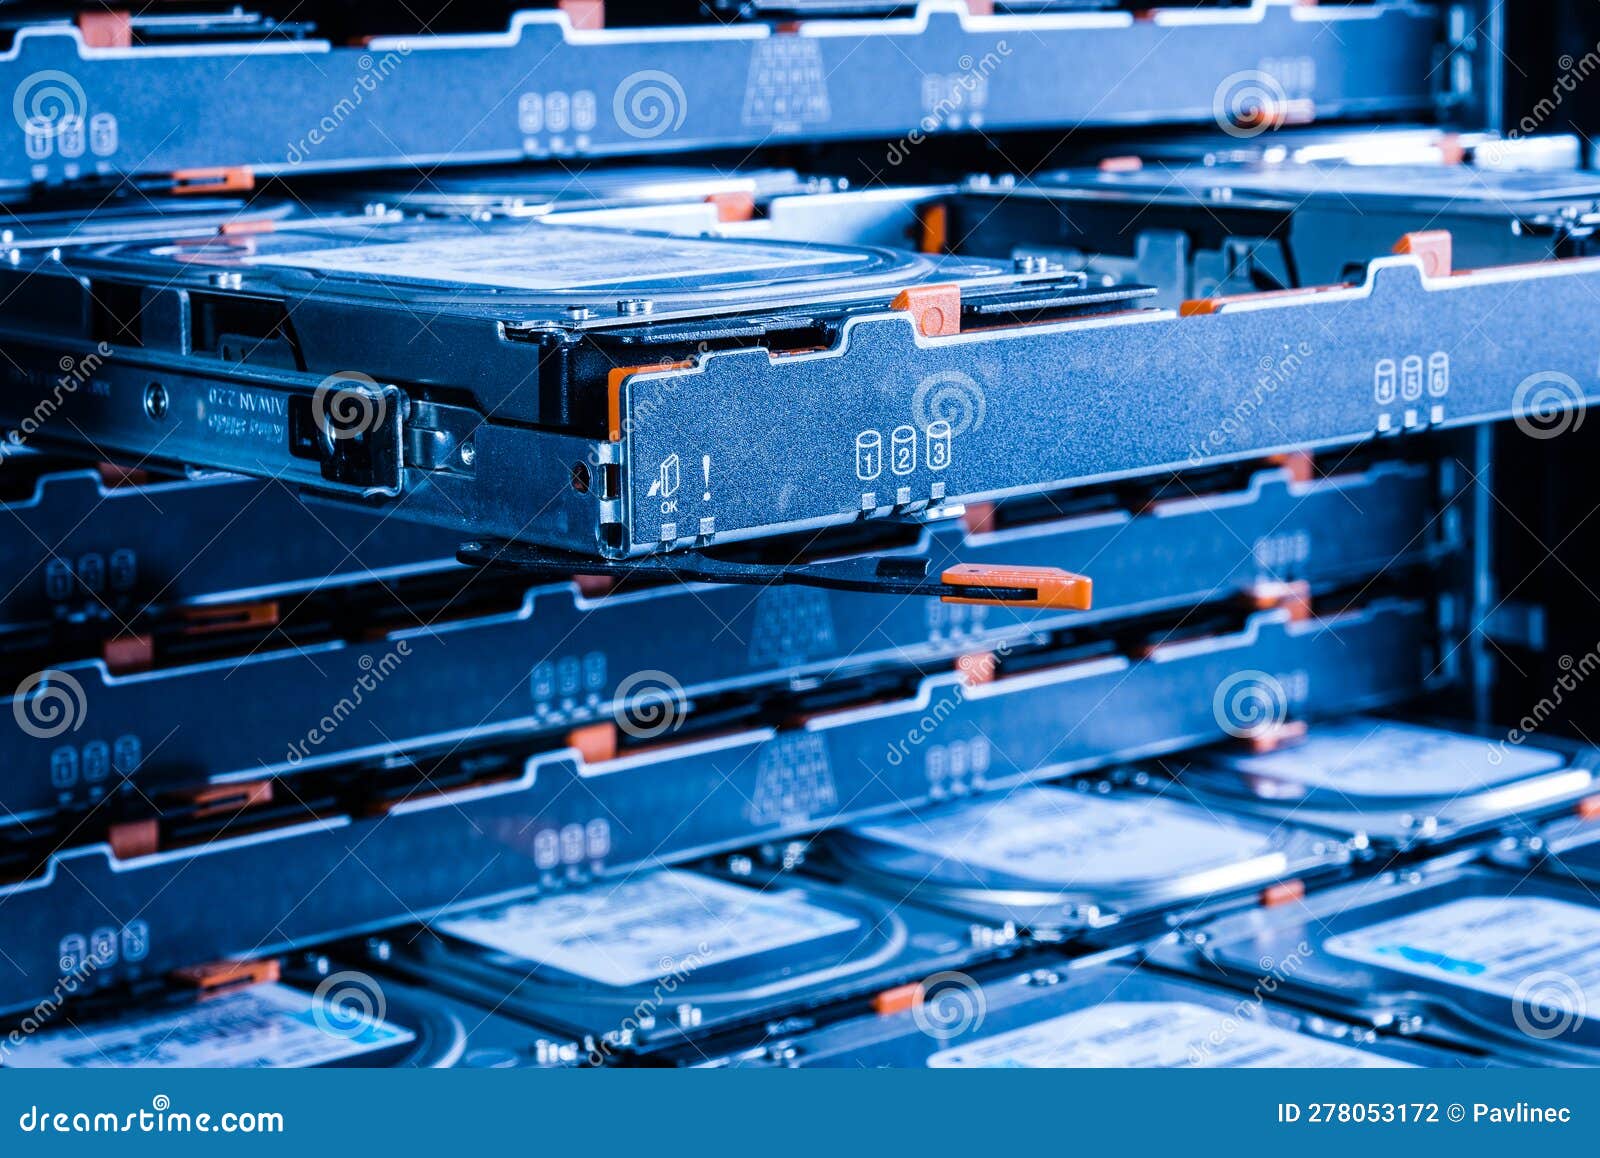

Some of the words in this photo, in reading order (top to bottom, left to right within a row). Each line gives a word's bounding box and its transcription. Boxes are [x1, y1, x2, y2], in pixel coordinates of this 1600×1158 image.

[240, 391, 288, 417] AIWAN
[863, 453, 872, 474] 1
[899, 447, 910, 469] 2
[933, 442, 945, 465] 3
[661, 500, 678, 514] OK
